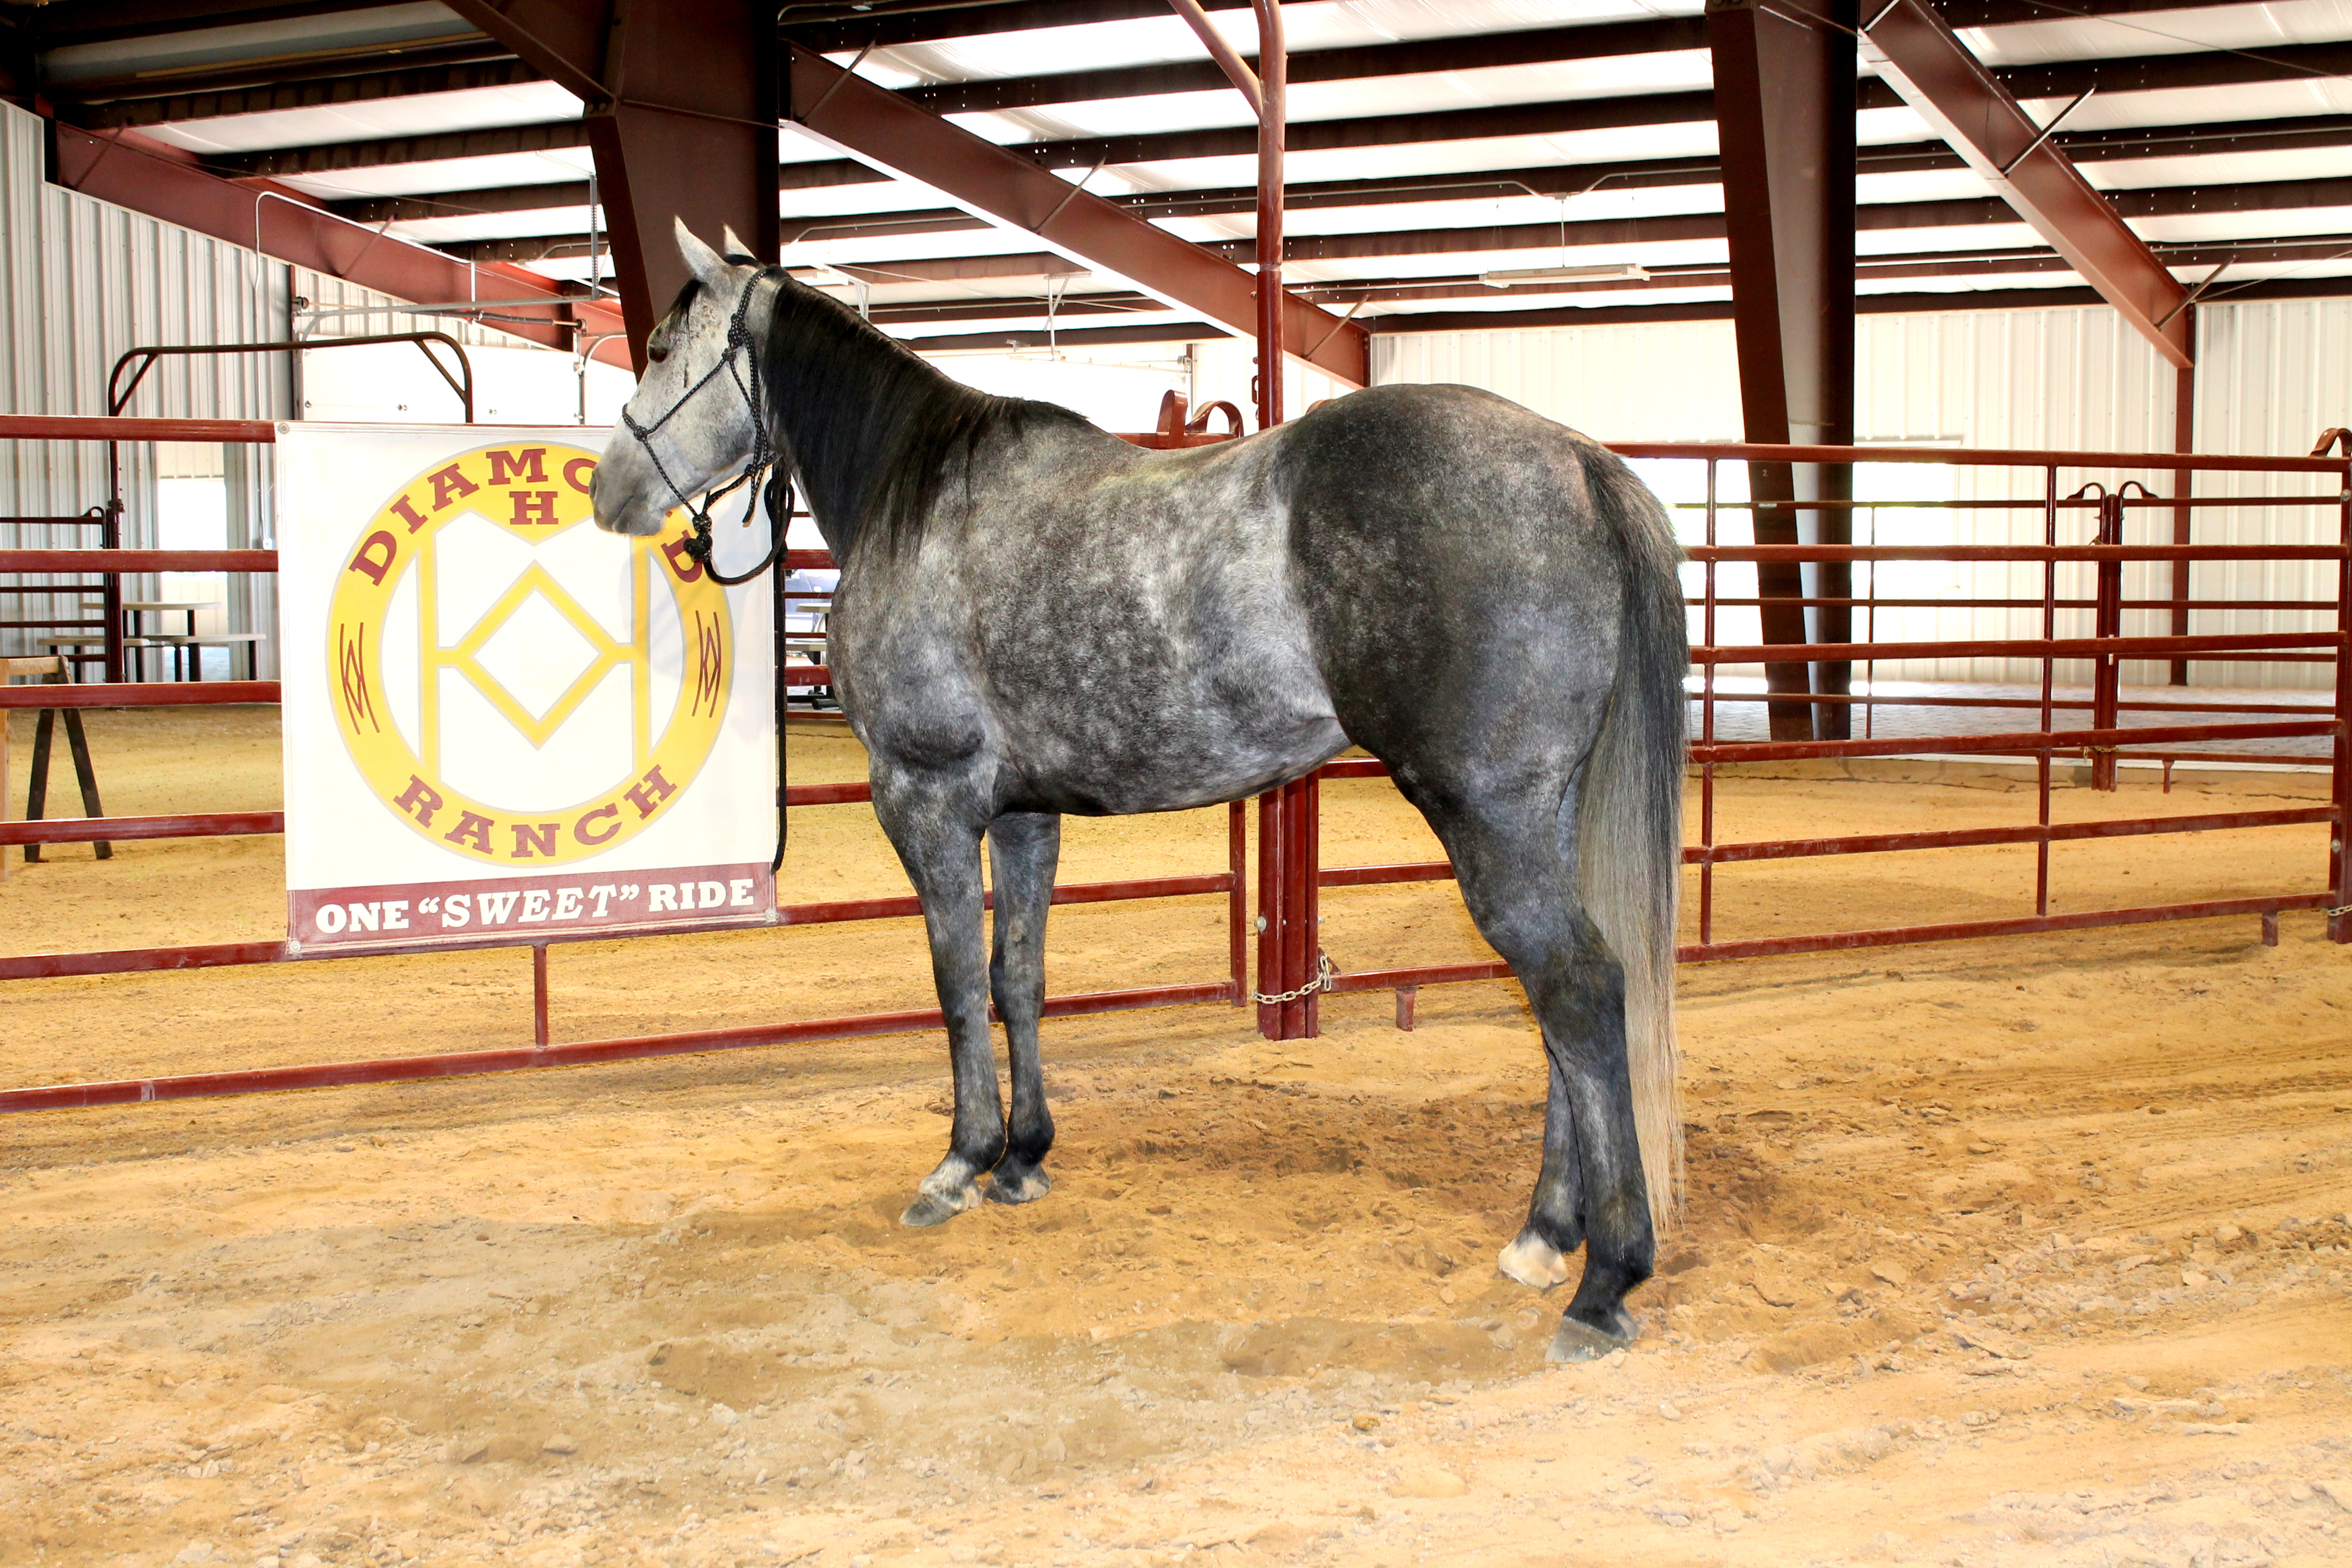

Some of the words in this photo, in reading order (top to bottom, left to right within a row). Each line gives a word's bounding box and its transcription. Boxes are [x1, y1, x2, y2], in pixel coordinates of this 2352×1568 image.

[349, 448, 703, 587] DIAMOD
[509, 491, 558, 525] H
[393, 764, 678, 858] RANCH
[315, 900, 410, 934] ONE
[418, 883, 640, 928] “SWEET”
[648, 878, 754, 912] RIDE
